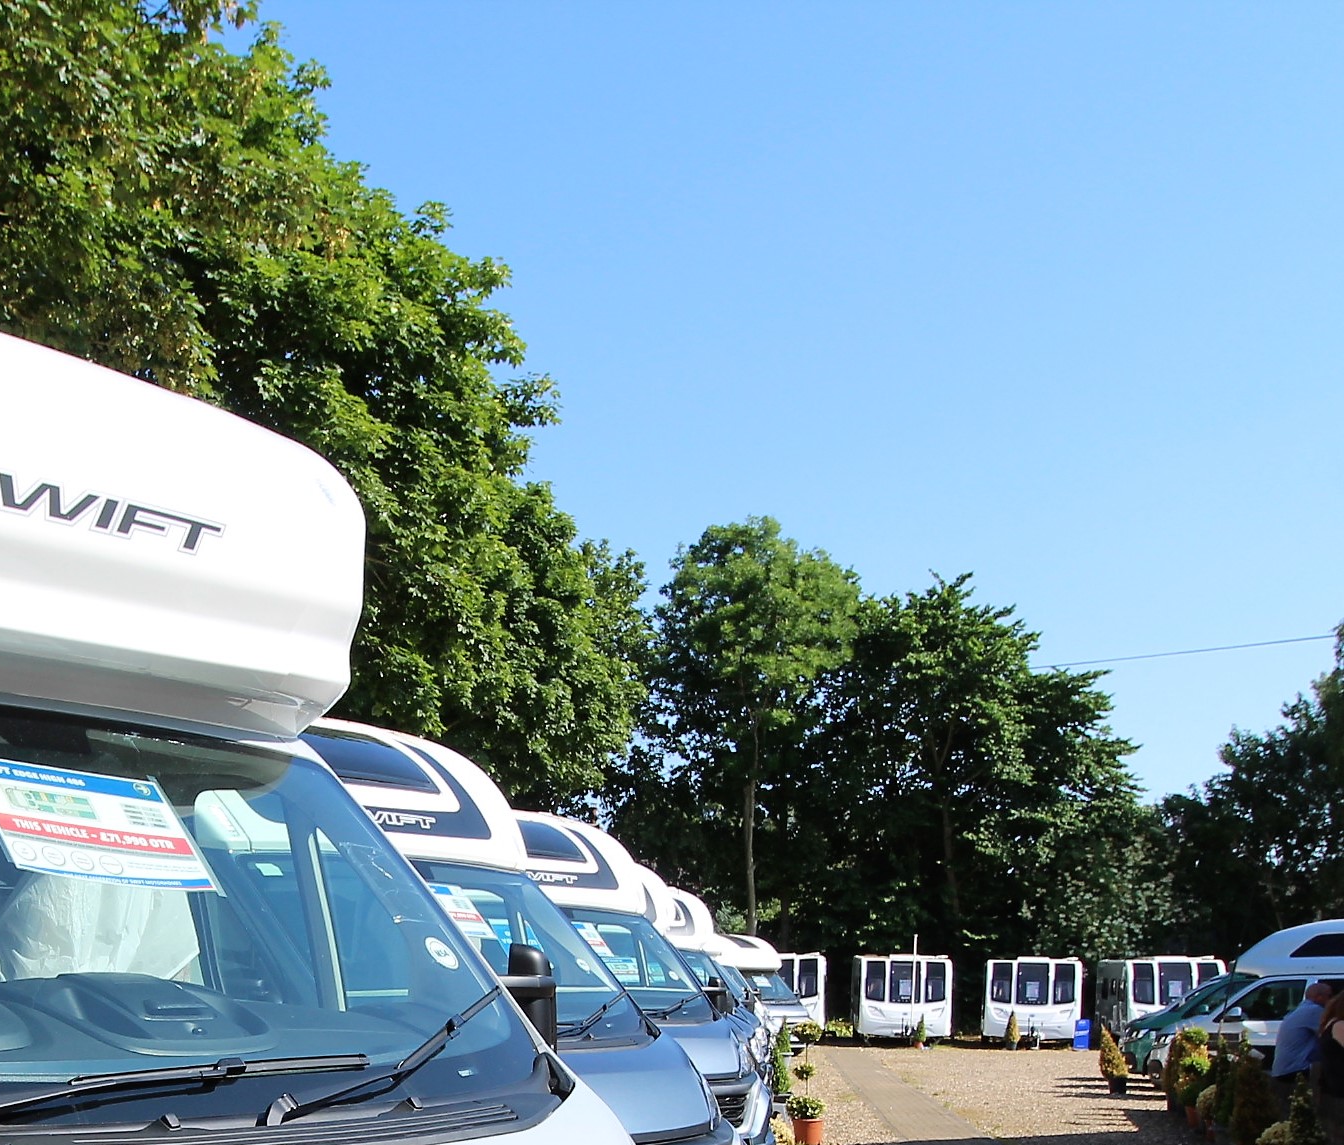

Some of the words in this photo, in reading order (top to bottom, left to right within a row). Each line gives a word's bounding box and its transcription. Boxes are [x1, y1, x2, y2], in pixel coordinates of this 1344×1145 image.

[12, 768, 40, 780] EDGE
[39, 773, 66, 784] HIGH
[366, 809, 436, 829] IFT
[12, 818, 42, 831] THIS
[42, 822, 90, 839] VEHICLE
[148, 838, 176, 850] OTR
[526, 871, 578, 884] IFT
